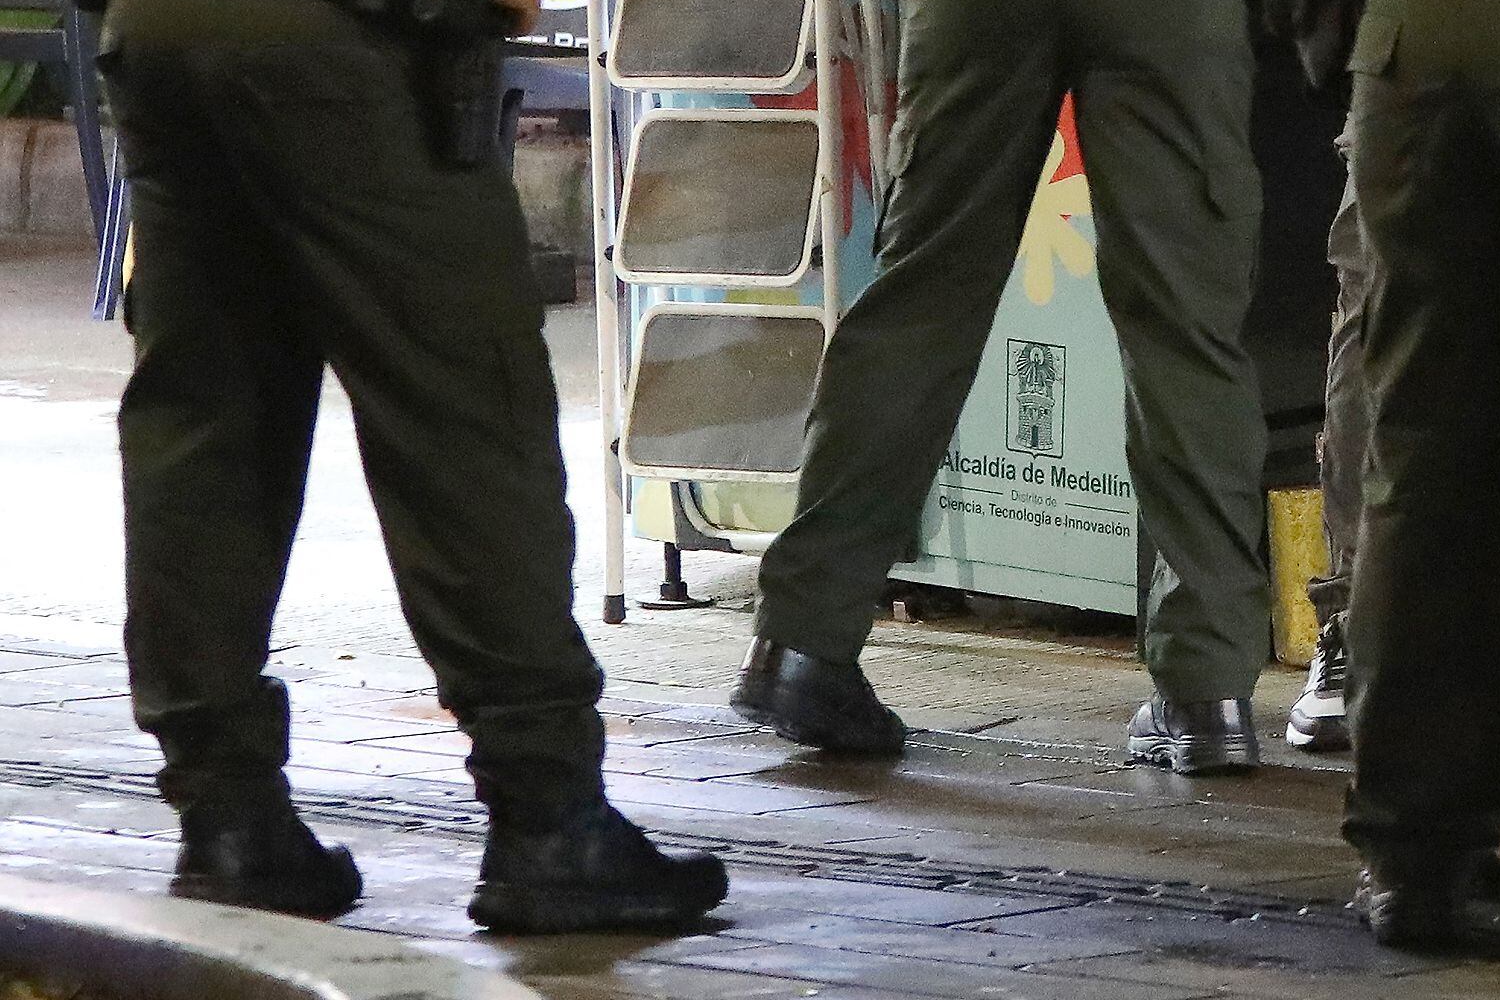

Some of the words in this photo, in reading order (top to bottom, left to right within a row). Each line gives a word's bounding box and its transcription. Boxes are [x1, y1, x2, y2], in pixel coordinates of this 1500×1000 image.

[940, 450, 1016, 481] Alcaldía
[1023, 462, 1045, 485] de
[1051, 466, 1131, 498] Medellín
[938, 495, 985, 516] Ciencia,
[989, 502, 1052, 527] Tecnología
[1054, 517, 1062, 527] e
[1063, 514, 1131, 538] Innovación
